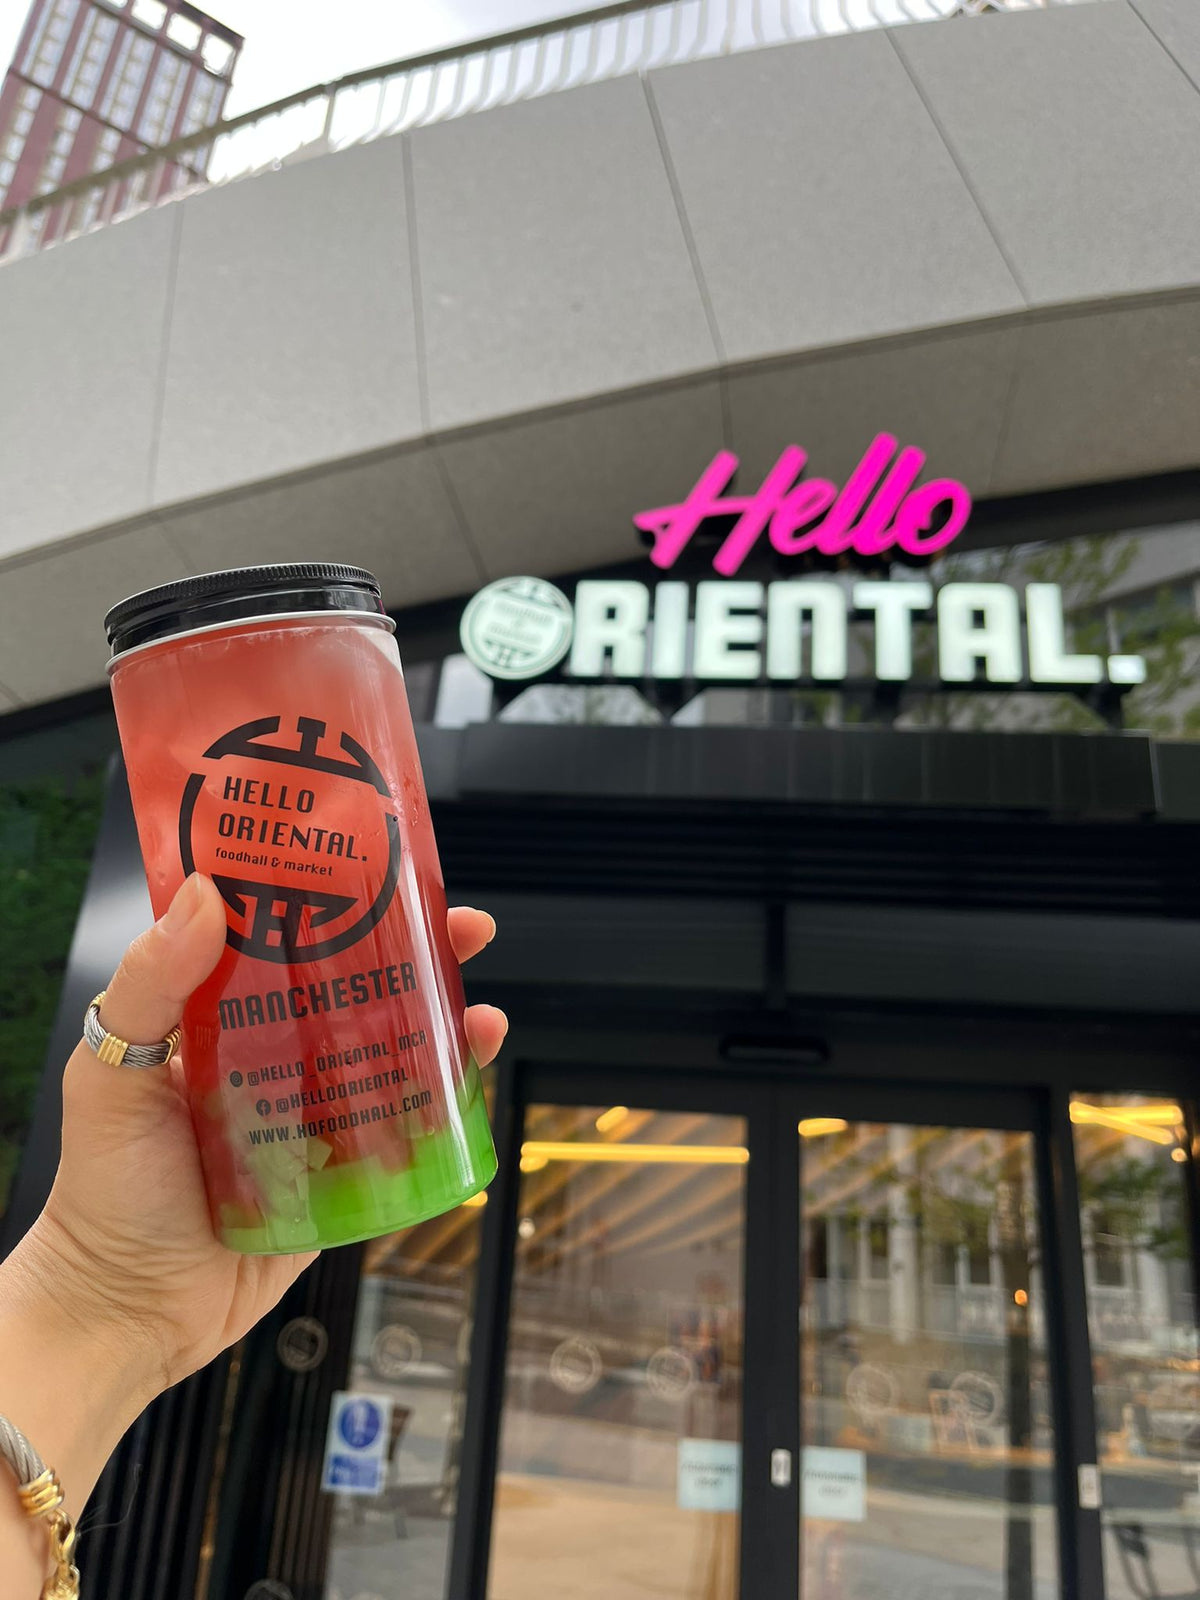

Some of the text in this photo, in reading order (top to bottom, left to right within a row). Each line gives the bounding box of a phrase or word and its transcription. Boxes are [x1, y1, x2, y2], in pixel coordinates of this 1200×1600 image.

[633, 431, 972, 577] Hello
[223, 775, 315, 814] HELLO
[215, 847, 333, 877] foodhall & market
[217, 812, 368, 863] ORIENTAL.
[218, 961, 417, 1030] MANCHESTER
[275, 1067, 408, 1113] @HELLOORIENTAL
[249, 1089, 432, 1145] WWW.HOFOODHALL.COM
